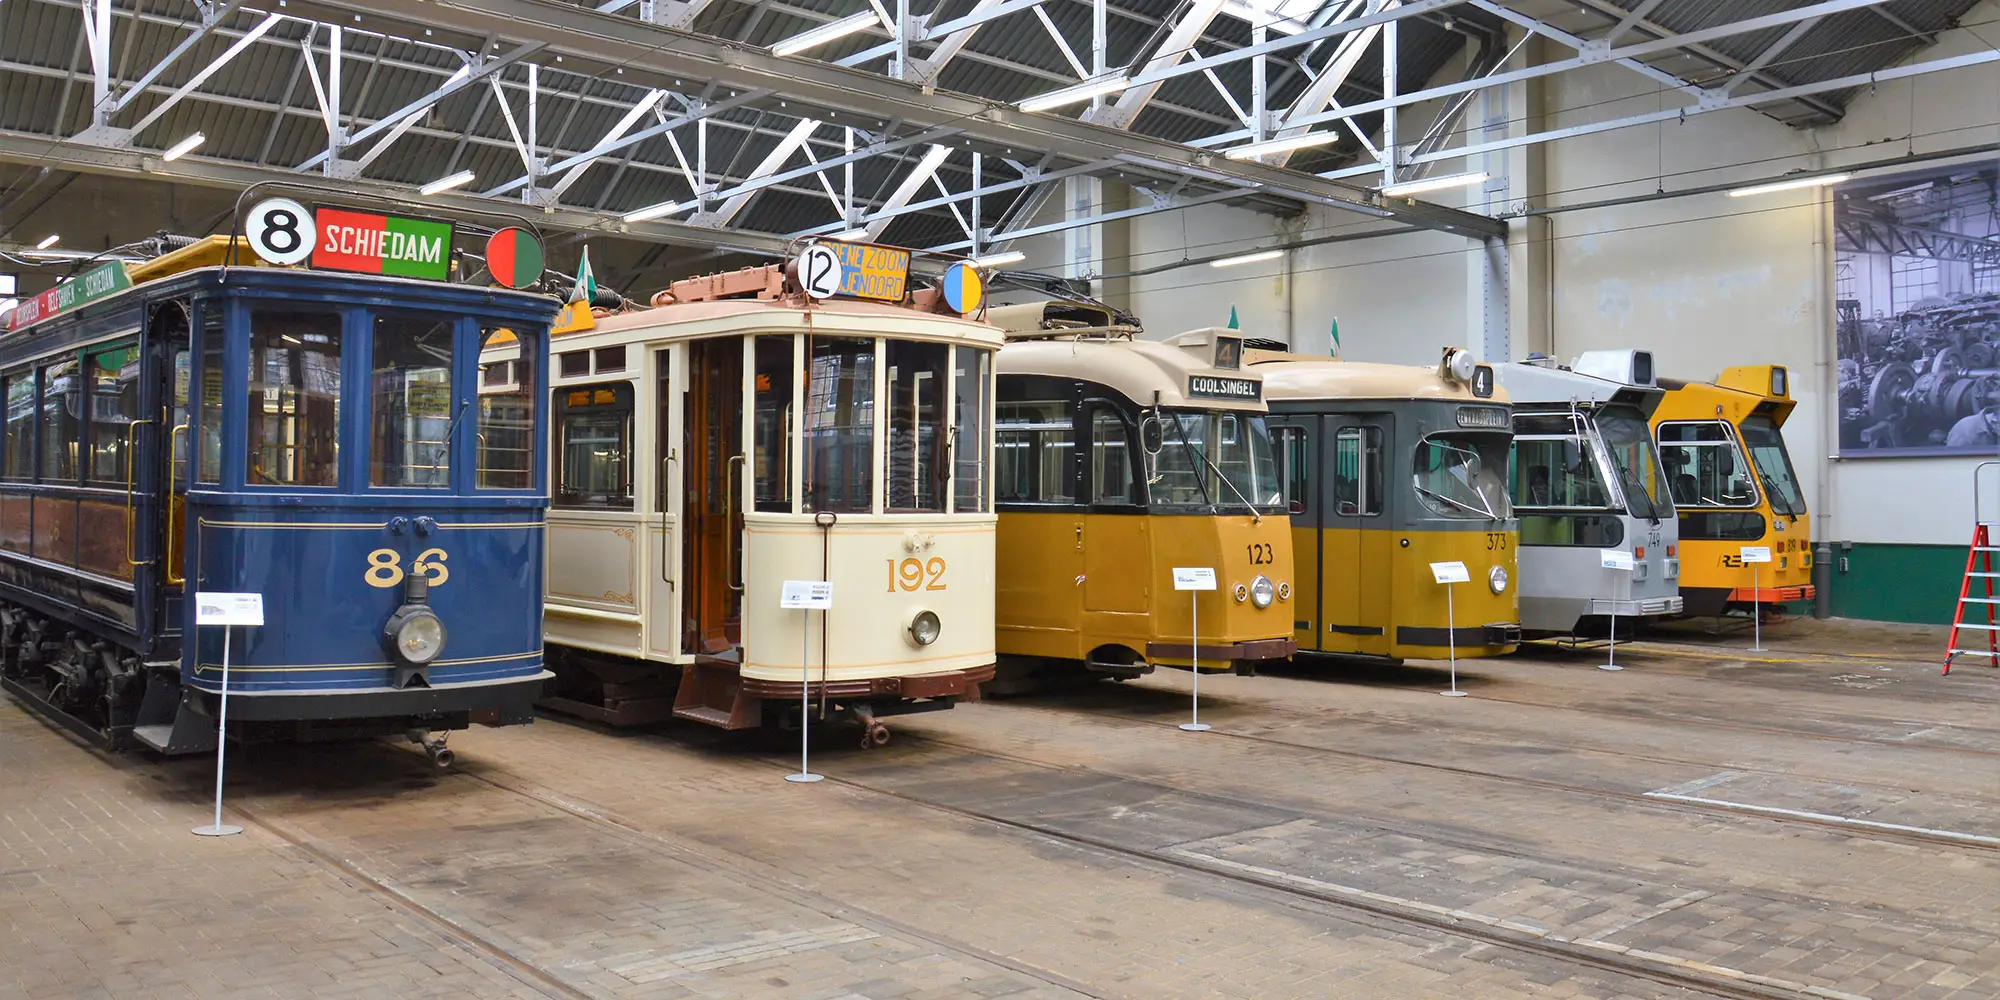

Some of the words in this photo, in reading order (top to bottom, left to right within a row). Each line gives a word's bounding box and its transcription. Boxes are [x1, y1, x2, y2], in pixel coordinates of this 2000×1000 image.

[261, 209, 301, 254] 8
[325, 224, 442, 264] SCHIEDAM
[806, 249, 832, 294] 12
[866, 248, 909, 272] ZOOM
[85, 266, 116, 297] SCHIEDAM
[1219, 343, 1233, 367] 4
[1192, 378, 1256, 396] COOLSINGEL
[1477, 371, 1485, 393] 4
[1246, 543, 1274, 565] 123
[1487, 533, 1507, 550] 373
[364, 548, 449, 588] 86
[886, 556, 947, 592] 192
